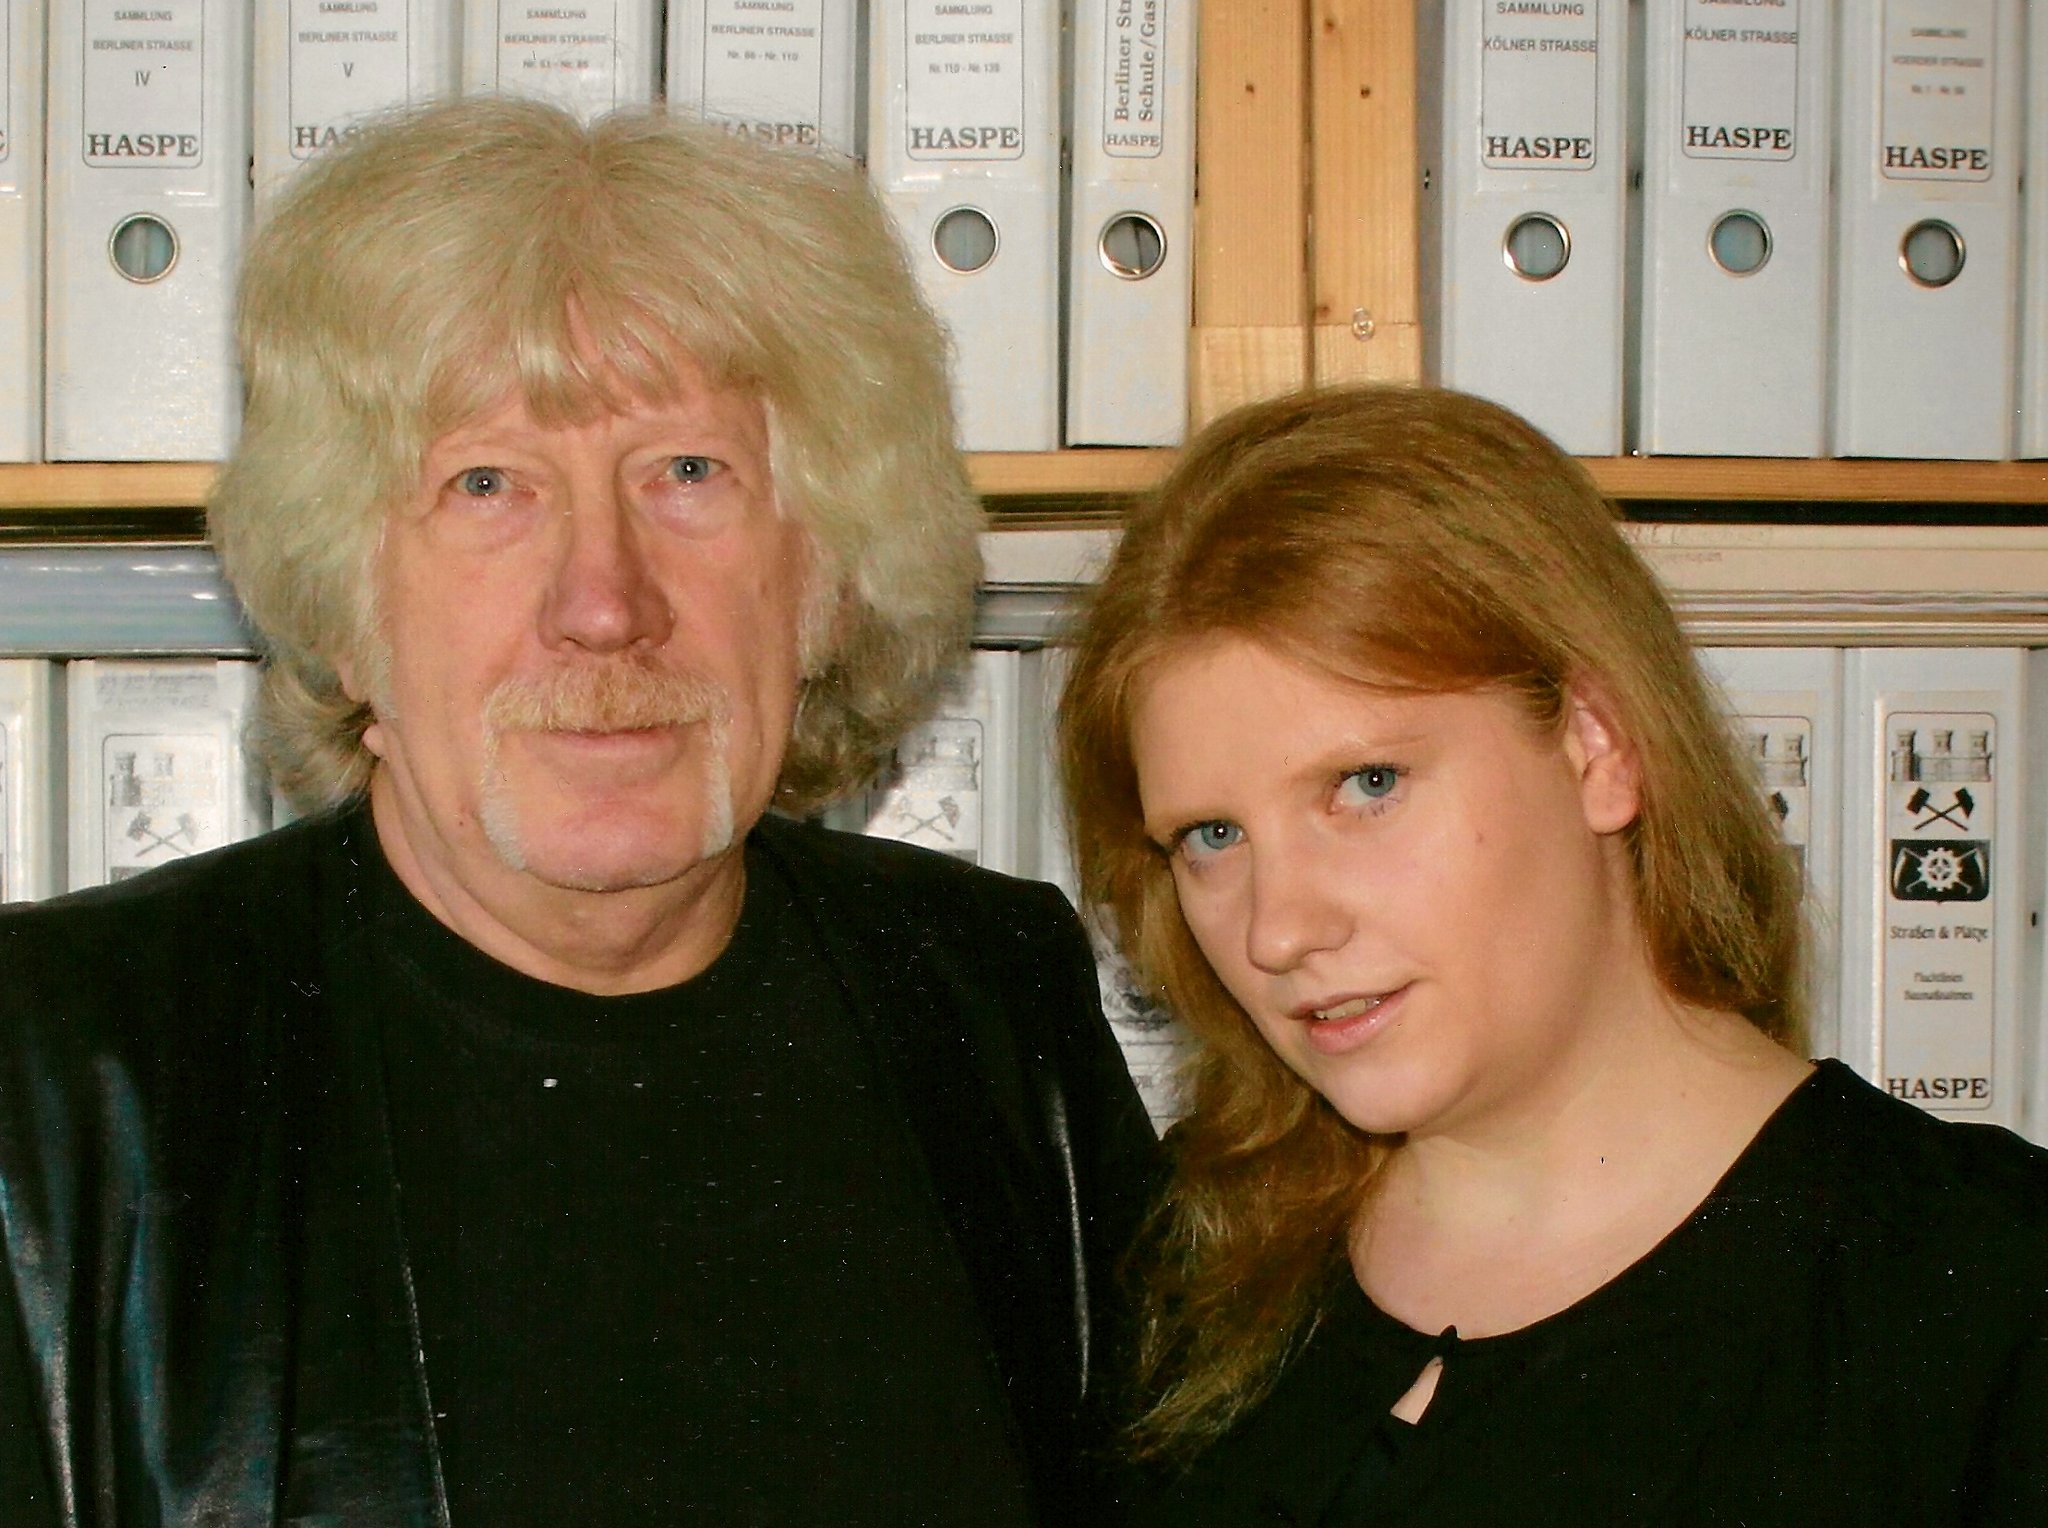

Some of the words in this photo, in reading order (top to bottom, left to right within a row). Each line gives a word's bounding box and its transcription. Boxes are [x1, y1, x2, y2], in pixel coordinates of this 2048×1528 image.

[526, 9, 586, 19] SAMMLUNG
[734, 1, 794, 12] SAMMLUNG
[935, 5, 993, 15] SAMMLUNG
[1496, 2, 1585, 16] SAMMLUNG
[114, 10, 172, 21] SAMMLUNG
[298, 31, 350, 43] BERLINER
[351, 31, 398, 42] STRASSE
[711, 25, 764, 35] BERLINER
[767, 26, 815, 37] STRASSE
[915, 34, 965, 44] BERLINER
[968, 33, 1014, 44] STRASSE
[1684, 26, 1737, 41] KÖLNER
[1740, 29, 1798, 44] STRASSE
[92, 40, 143, 50] BERLINER
[146, 40, 193, 51] STRASSE
[504, 34, 557, 44] BERLINER
[1483, 38, 1536, 51] KÖLNER
[1539, 40, 1596, 52] STRASSE
[1138, 0, 1157, 122] Schule/Gas
[342, 62, 354, 78] V
[134, 71, 151, 87] IV
[1114, 35, 1131, 121] Berliner
[721, 121, 816, 145] ASPE
[911, 127, 1020, 149] HASPE
[1106, 134, 1160, 147] HASPE
[1687, 126, 1792, 150] HASPE
[87, 133, 199, 158] HASPE
[1487, 136, 1593, 160] HASPE
[1885, 146, 1988, 170] HASPE
[1888, 1077, 1989, 1100] HASPE
